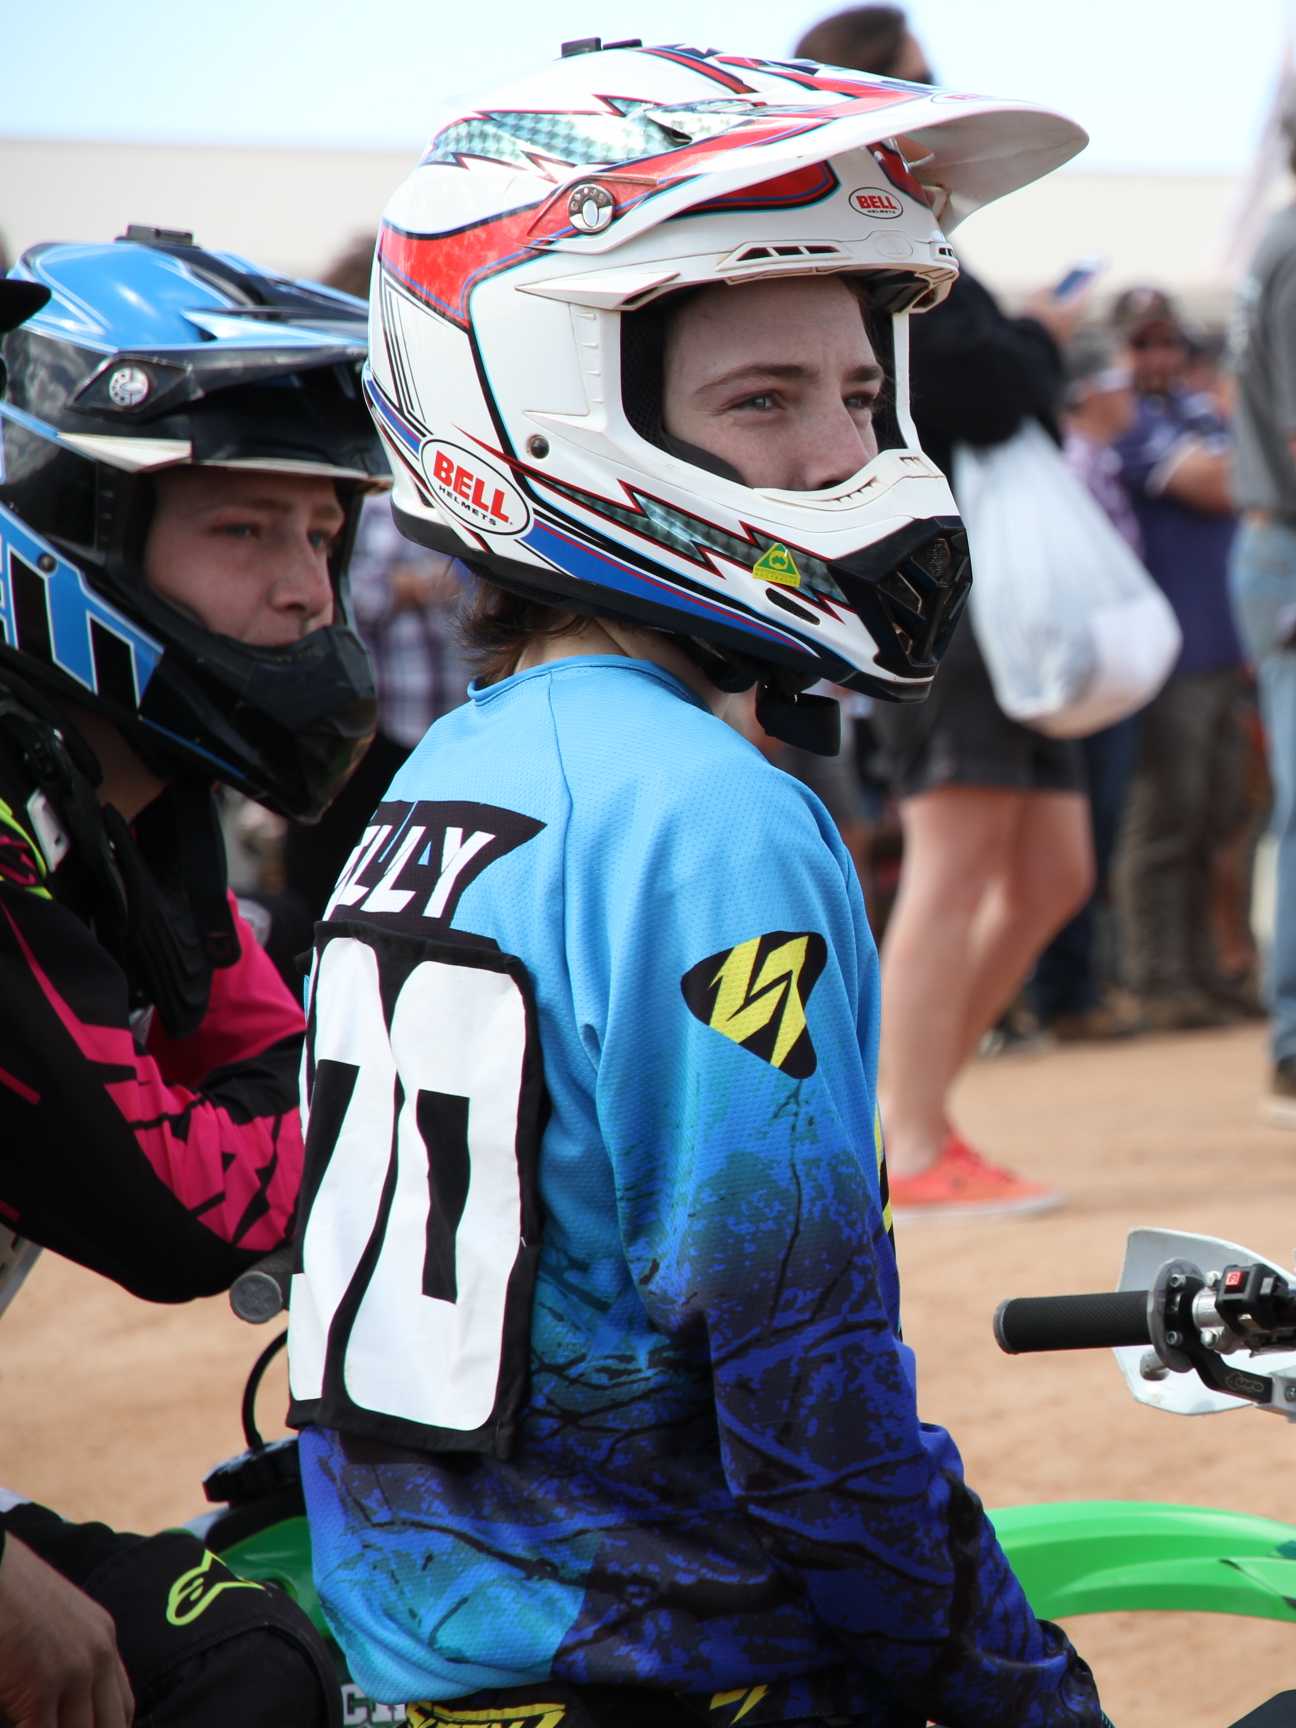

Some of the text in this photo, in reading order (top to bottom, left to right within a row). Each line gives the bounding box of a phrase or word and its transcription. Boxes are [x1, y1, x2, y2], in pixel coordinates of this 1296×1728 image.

[856, 195, 898, 210] BELL
[433, 449, 510, 524] BELL
[438, 484, 497, 526] HELMETS
